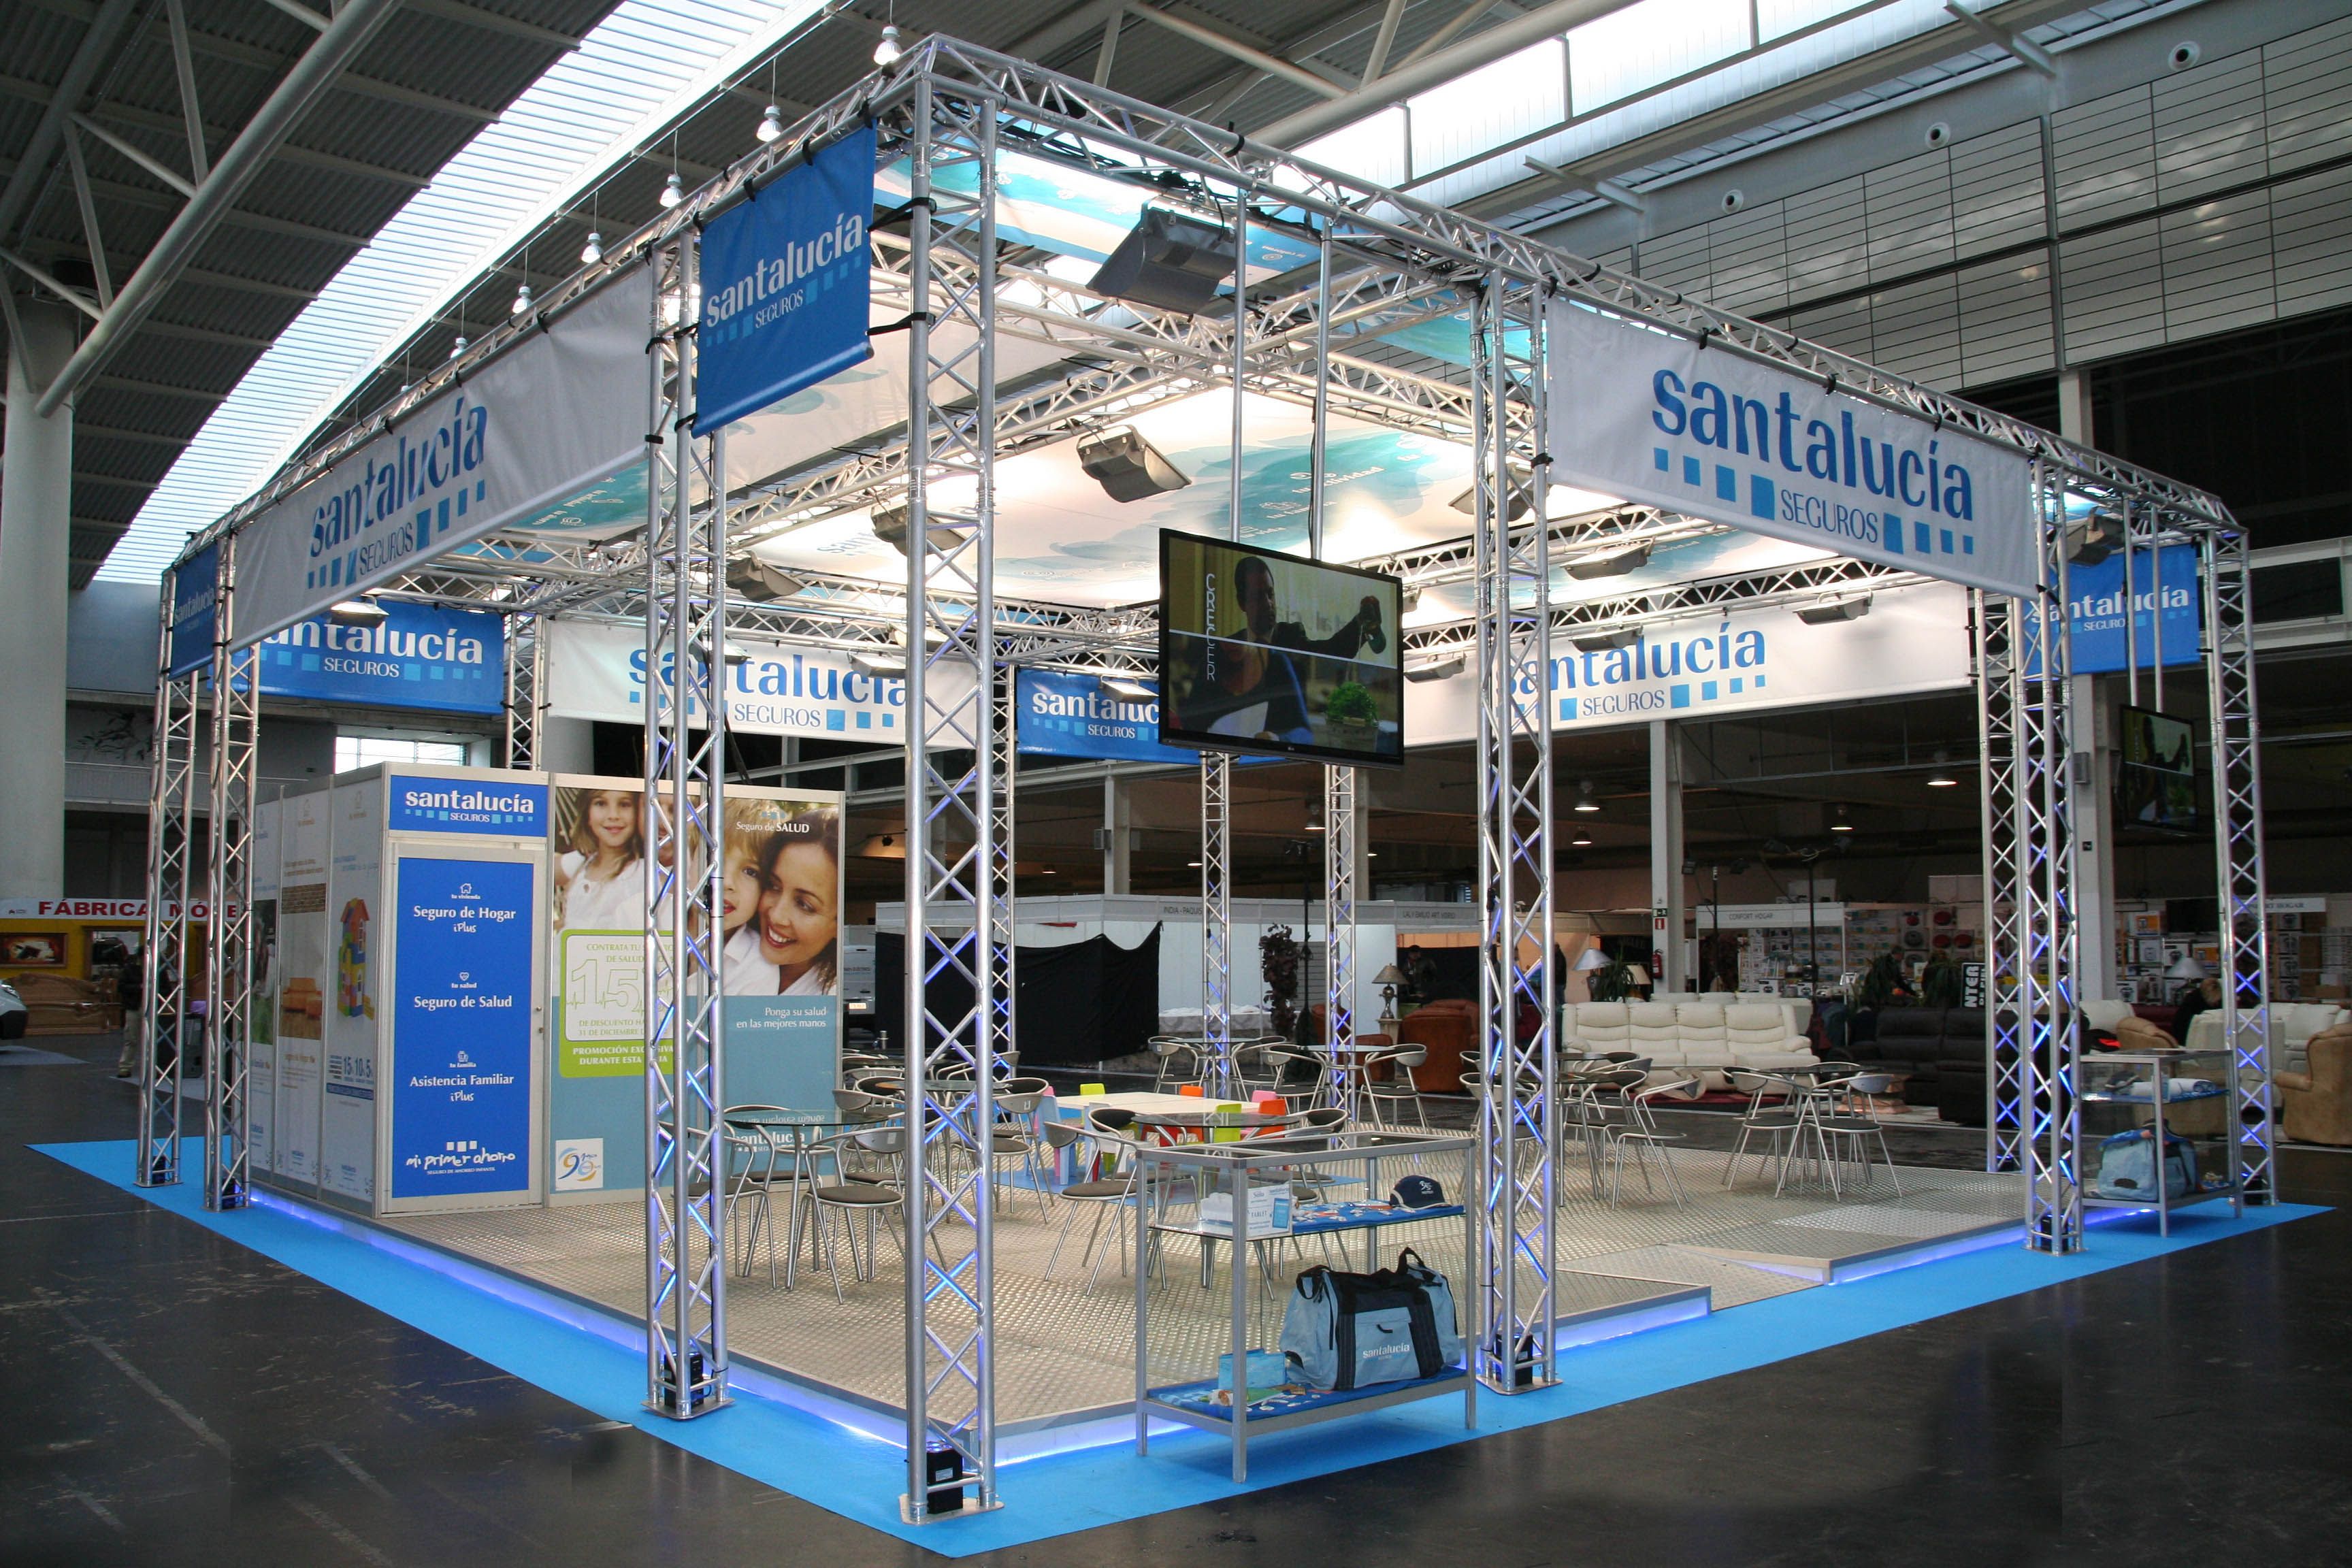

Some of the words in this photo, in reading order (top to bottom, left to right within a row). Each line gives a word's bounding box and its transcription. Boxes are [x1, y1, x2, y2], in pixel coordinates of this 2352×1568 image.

[706, 213, 863, 327] santalucía
[755, 290, 804, 329] SEGUROS
[1652, 370, 1973, 521] santalucía
[310, 396, 488, 557] santalucía
[1781, 490, 1878, 544] SEGUROS
[360, 522, 414, 575] SEGUROS
[2084, 618, 2126, 631] SEGURO
[263, 620, 484, 664] antalucía
[325, 657, 400, 678] SEGUROS
[1032, 691, 1160, 724] santaluc
[1584, 690, 1665, 716] SEGUROS
[735, 704, 821, 727] SEGUROS
[1088, 724, 1136, 739] SEGUROS
[406, 790, 534, 813] santalucía
[450, 813, 491, 823] SEGUROS
[736, 821, 762, 832] Seguro
[764, 823, 774, 831] de
[776, 823, 810, 833] SALUD
[39, 898, 148, 916] FÁBRICA
[414, 905, 456, 921] Seguro
[460, 906, 475, 917] de
[479, 907, 517, 922] Hogar
[453, 921, 476, 933] iPlus
[572, 959, 640, 1013] 15
[414, 996, 457, 1011] Seguro
[461, 995, 476, 1007] de
[479, 995, 512, 1007] Salud
[765, 1007, 790, 1018] Ponga
[804, 1007, 827, 1015] salud
[750, 1019, 762, 1028] las
[764, 1019, 797, 1030] mejores
[573, 1045, 629, 1055] PROMOCIÓN
[580, 1056, 620, 1065] DURANTE
[410, 1074, 467, 1087] Asistencia
[470, 1073, 514, 1085] Familiar
[450, 1090, 474, 1102] iPlus
[406, 1155, 421, 1168] mi
[423, 1154, 471, 1170] primer
[472, 1147, 516, 1164] ahorro
[1362, 1342, 1411, 1359] santalucía
